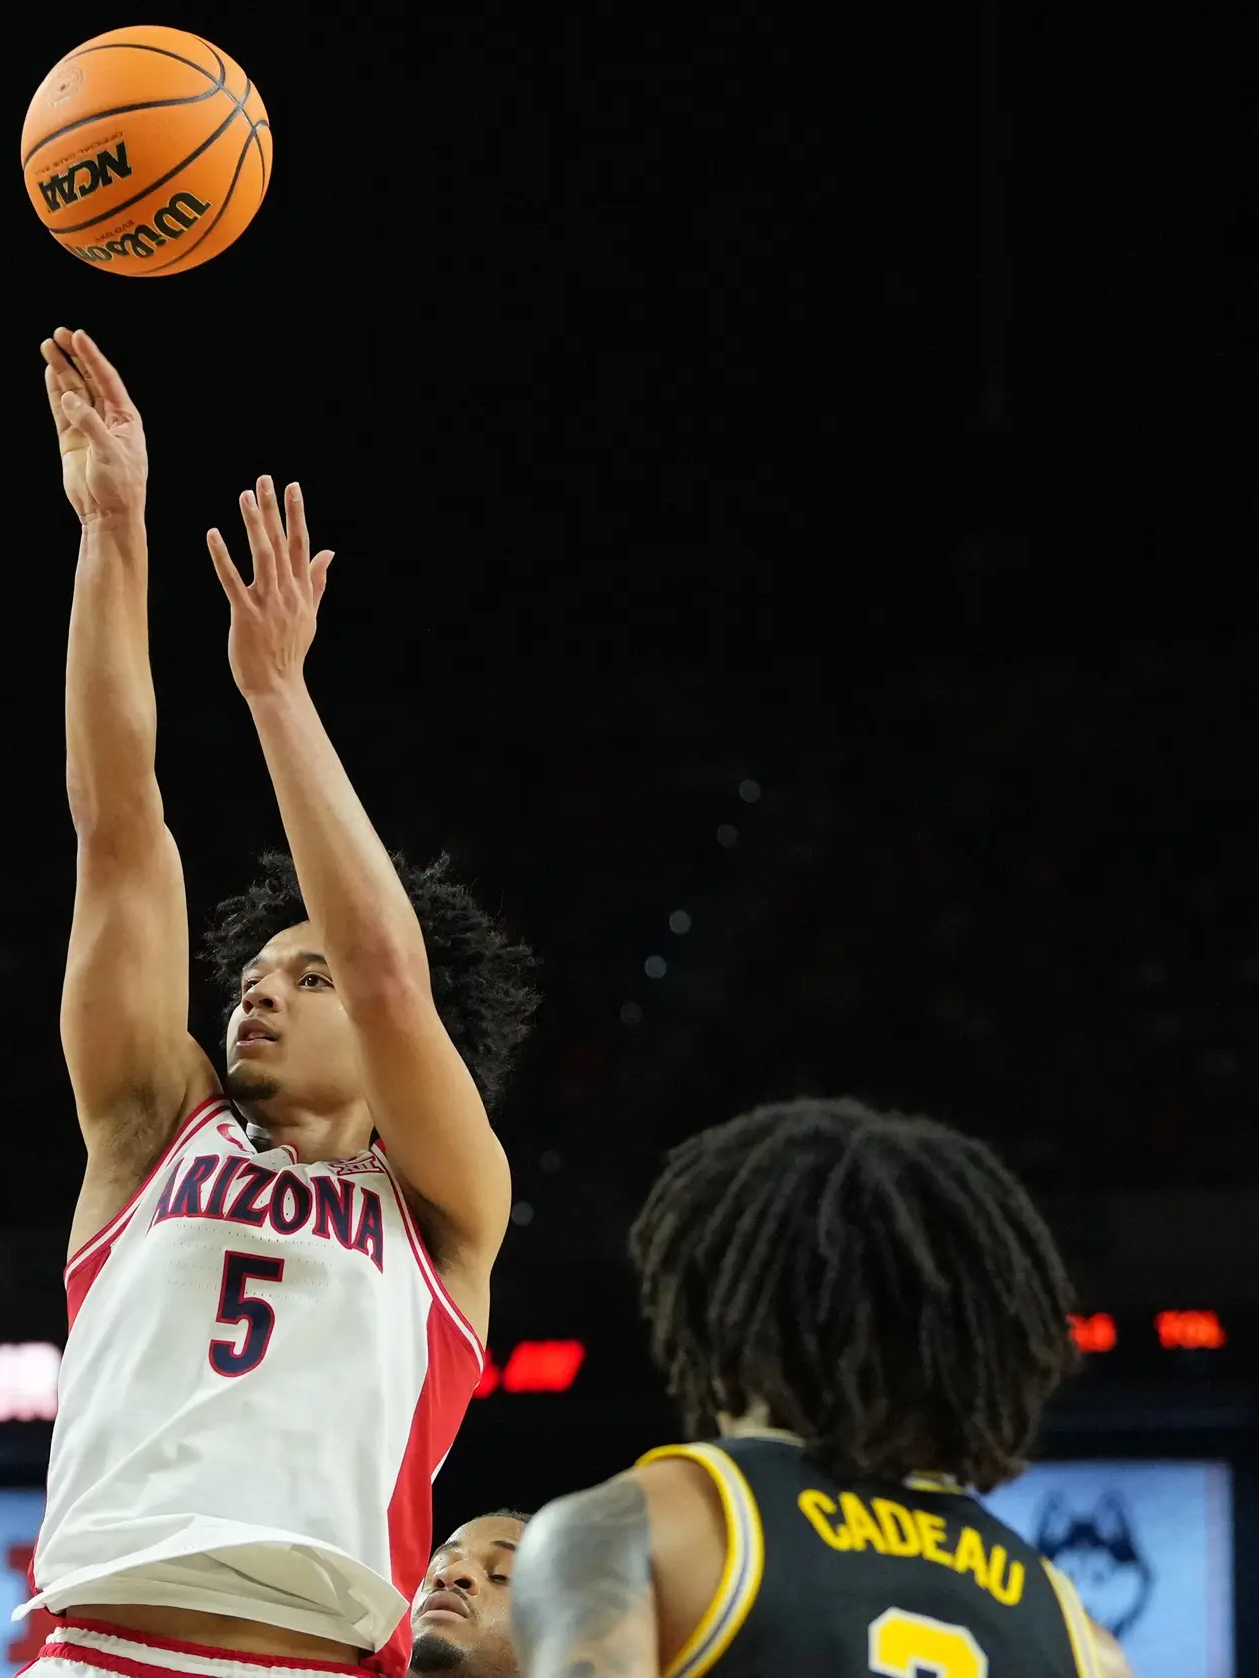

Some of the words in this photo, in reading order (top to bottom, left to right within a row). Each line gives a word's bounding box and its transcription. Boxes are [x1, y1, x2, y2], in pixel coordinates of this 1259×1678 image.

[38, 140, 132, 213] NCAA
[68, 191, 212, 263] Wilson
[146, 1153, 384, 1275] ARIZONA
[208, 1250, 285, 1378] 5
[797, 1488, 1026, 1607] CADEAU
